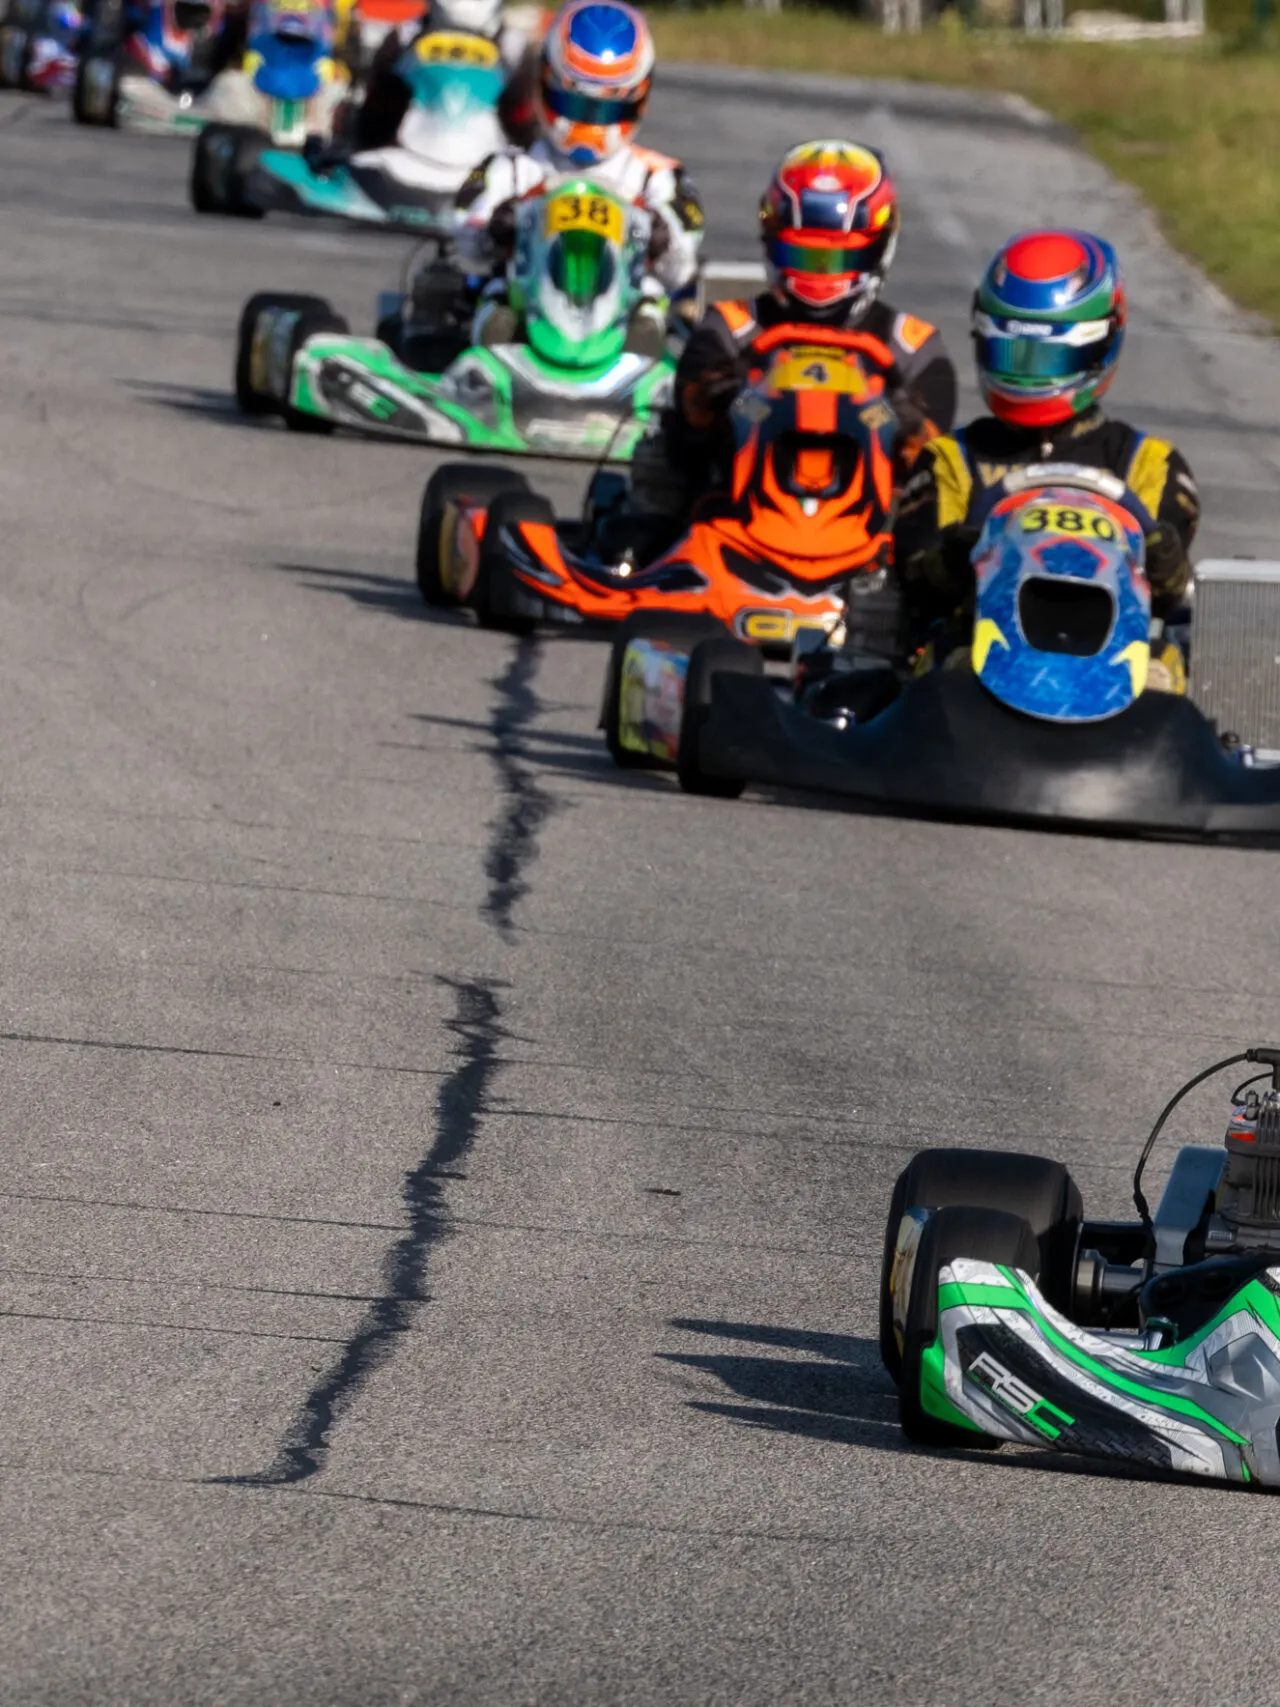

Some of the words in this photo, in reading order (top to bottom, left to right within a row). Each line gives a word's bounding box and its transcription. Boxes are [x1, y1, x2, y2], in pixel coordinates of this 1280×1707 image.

[560, 196, 610, 225] 38
[802, 362, 828, 383] 4
[1022, 508, 1116, 541] 380
[967, 1351, 1076, 1440] RSC
